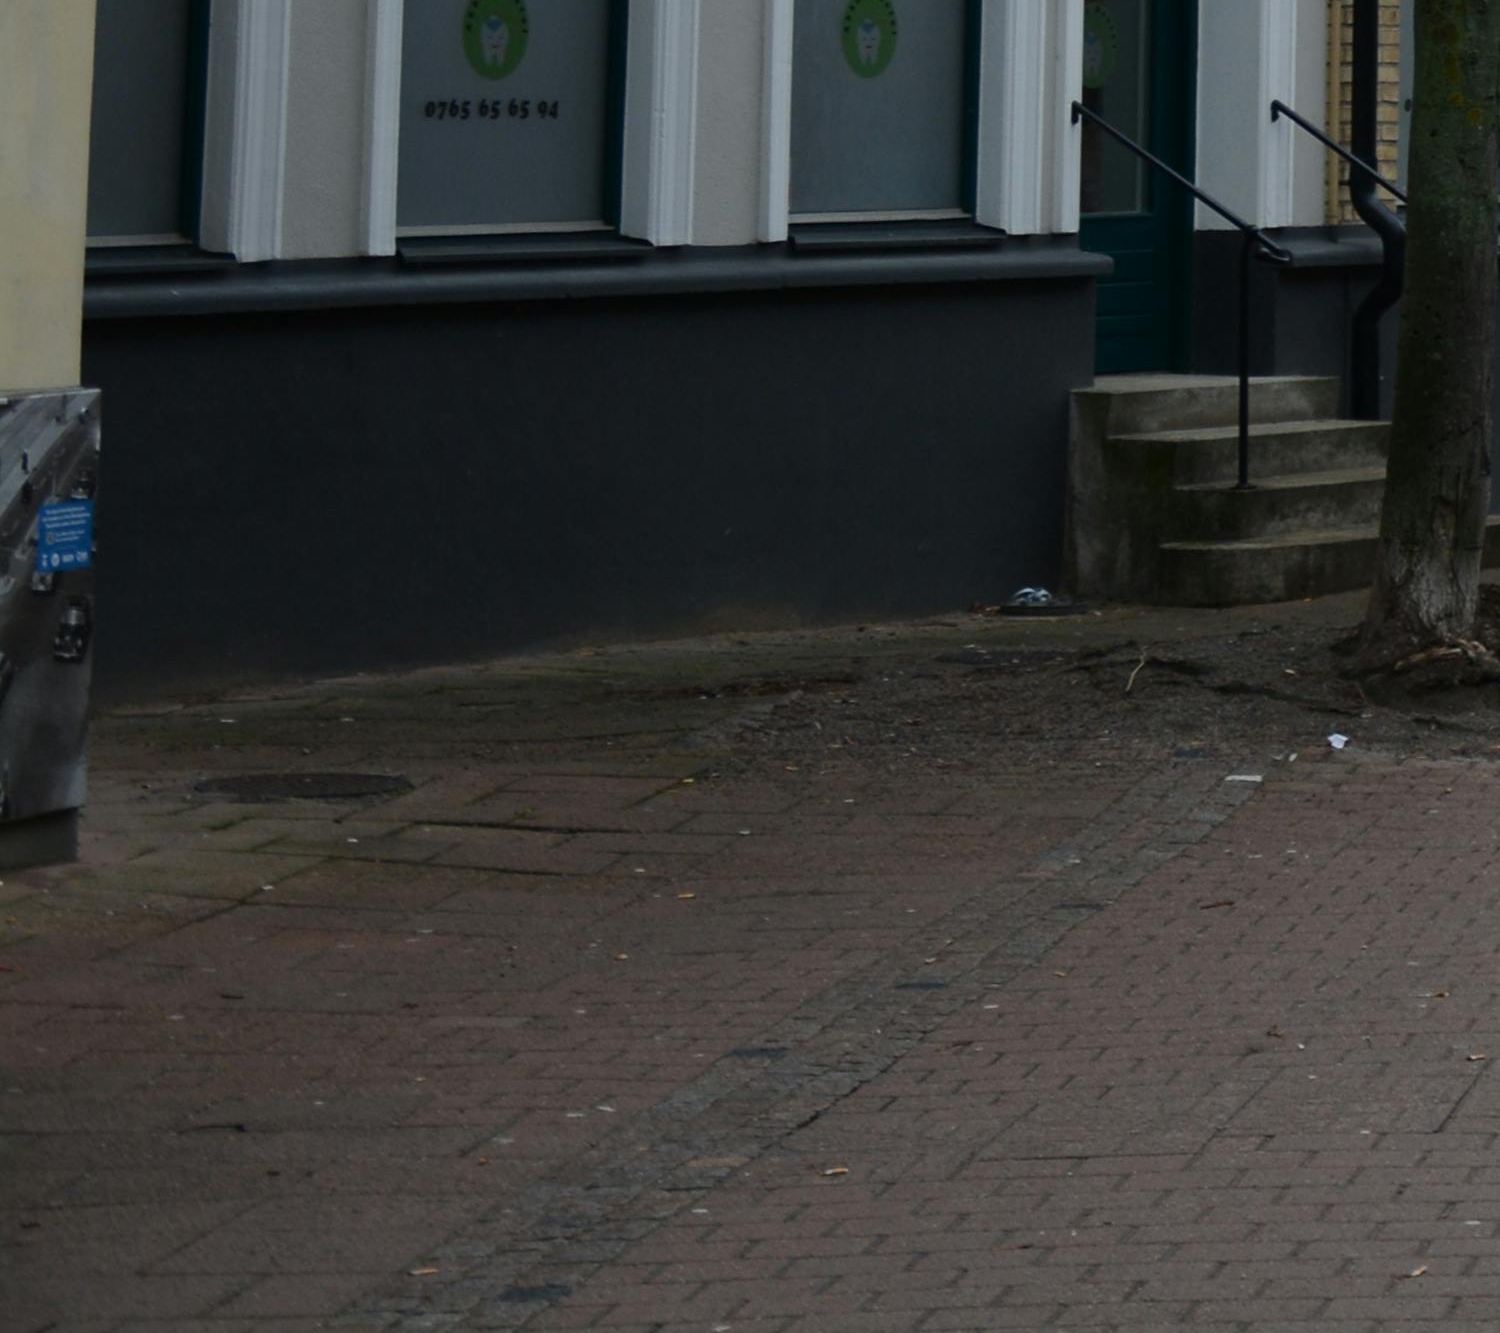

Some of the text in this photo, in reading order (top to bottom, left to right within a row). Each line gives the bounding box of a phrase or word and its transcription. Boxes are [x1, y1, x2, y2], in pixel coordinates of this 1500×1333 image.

[424, 98, 559, 120] 0765 65 65 94
